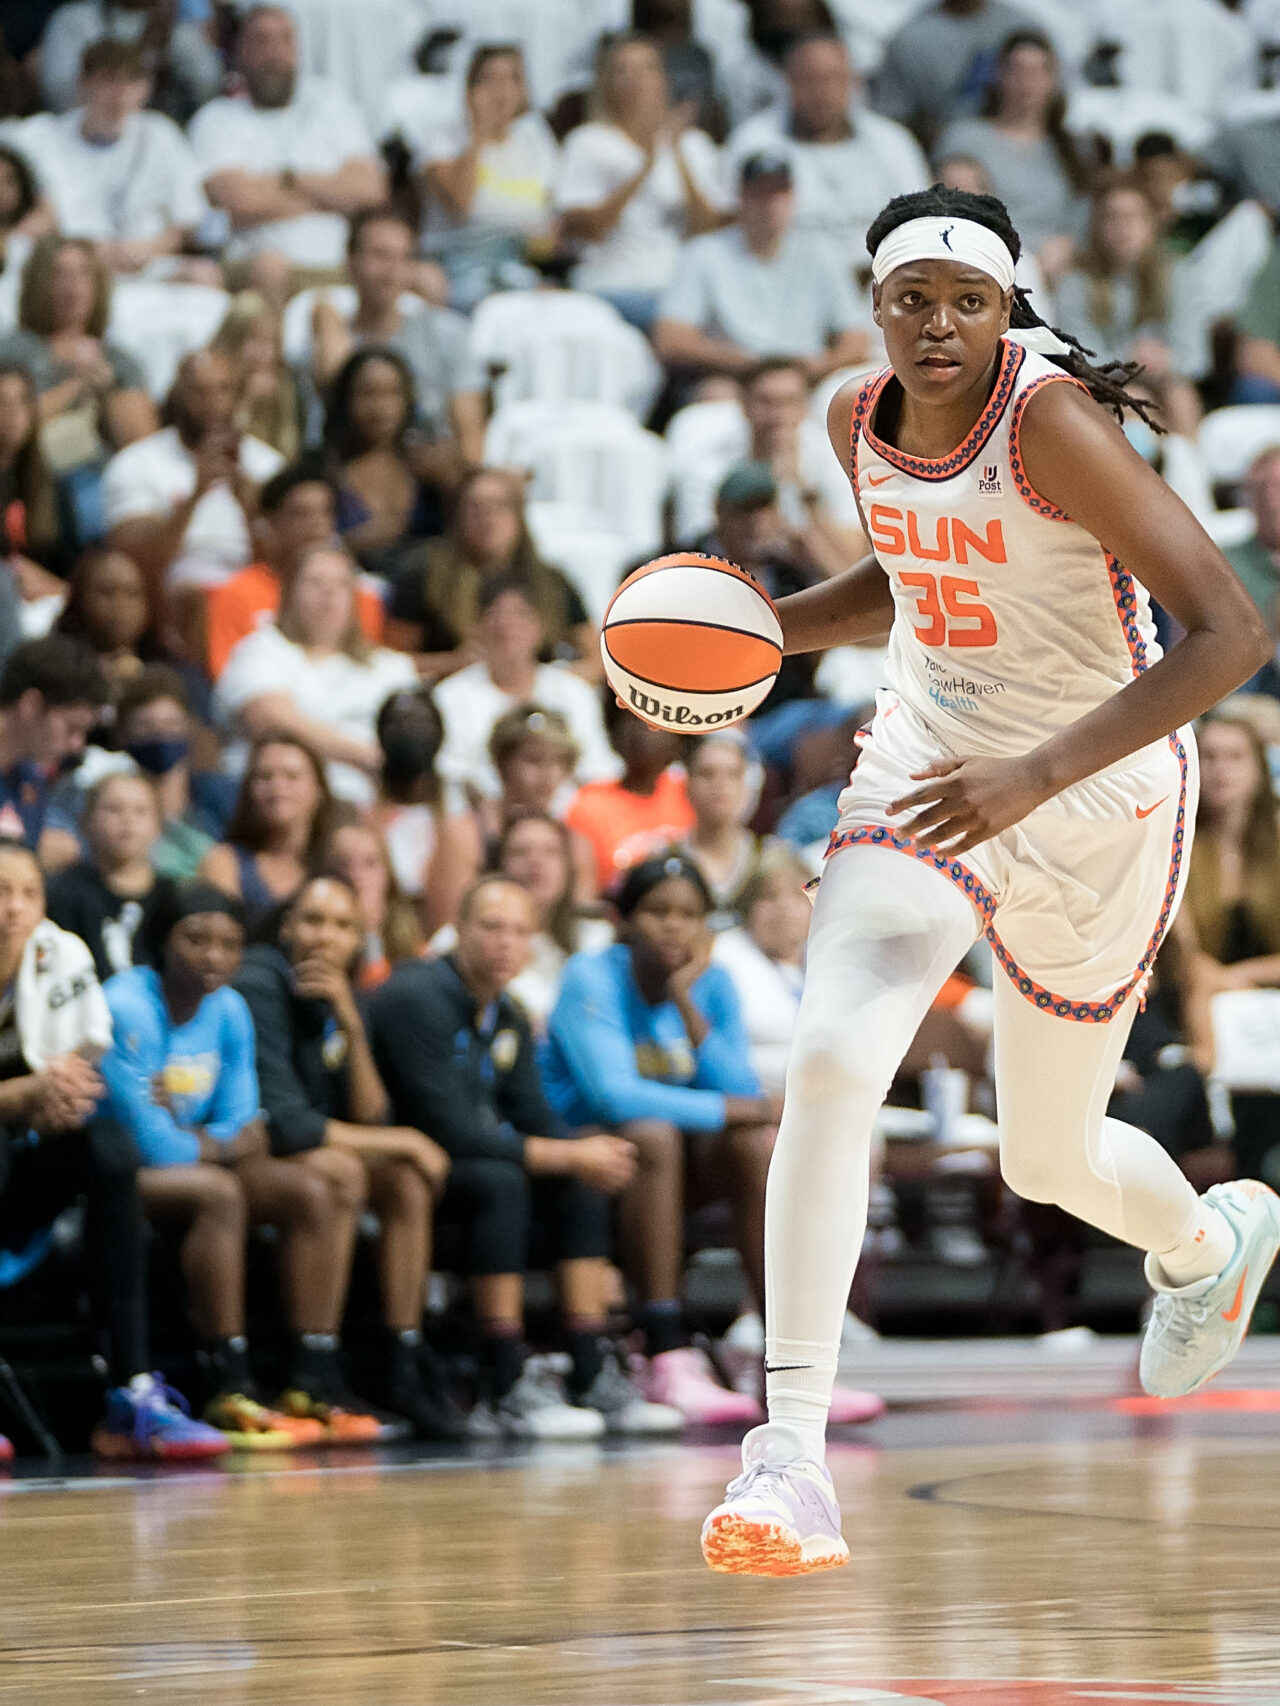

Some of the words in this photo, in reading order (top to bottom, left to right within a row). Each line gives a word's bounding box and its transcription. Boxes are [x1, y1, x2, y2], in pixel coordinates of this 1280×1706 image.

[978, 479, 1002, 491] Post
[870, 503, 1008, 565] SUN
[897, 571, 998, 648] 35
[629, 683, 744, 725] Wilson
[929, 676, 1006, 695] ewHaven
